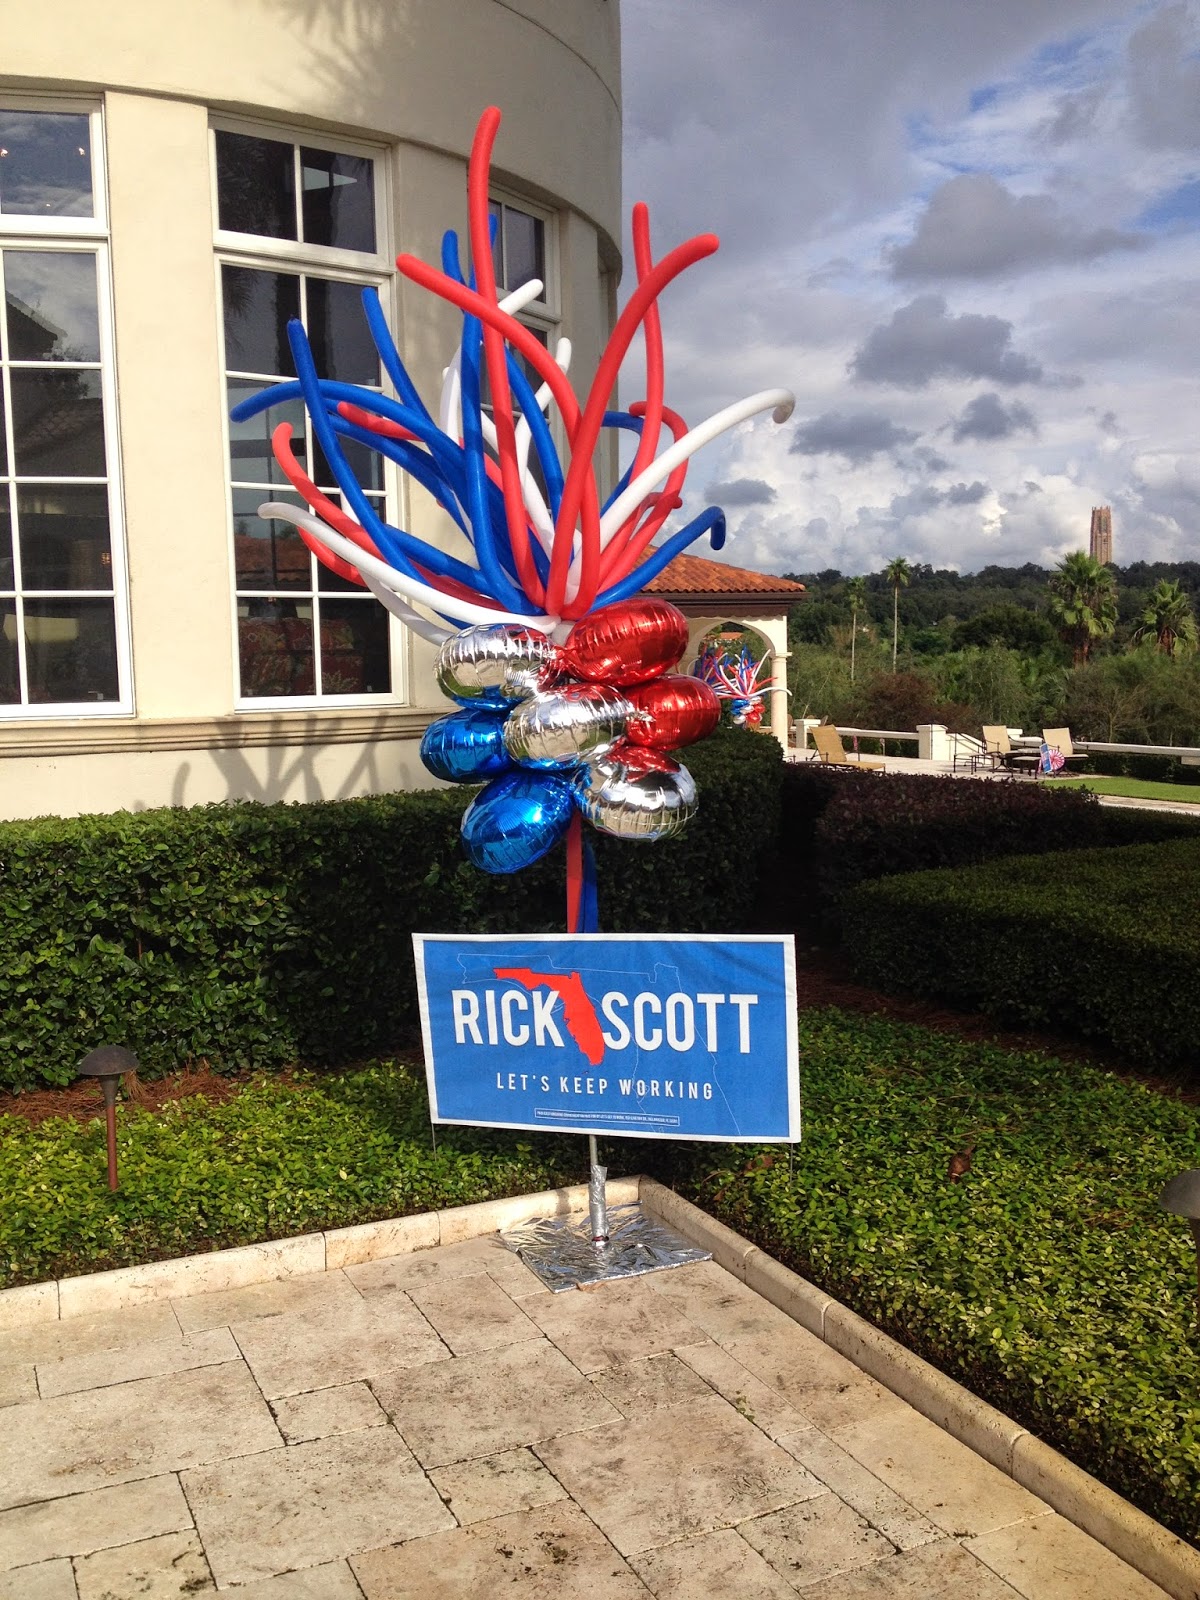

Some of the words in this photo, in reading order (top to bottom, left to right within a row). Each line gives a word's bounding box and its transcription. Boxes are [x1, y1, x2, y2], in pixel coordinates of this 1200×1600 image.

[451, 989, 565, 1047] RICK
[601, 991, 759, 1053] SCOTT
[497, 1072, 550, 1092] LET'S
[560, 1076, 608, 1095] KEEP
[619, 1079, 714, 1100] WORKING
